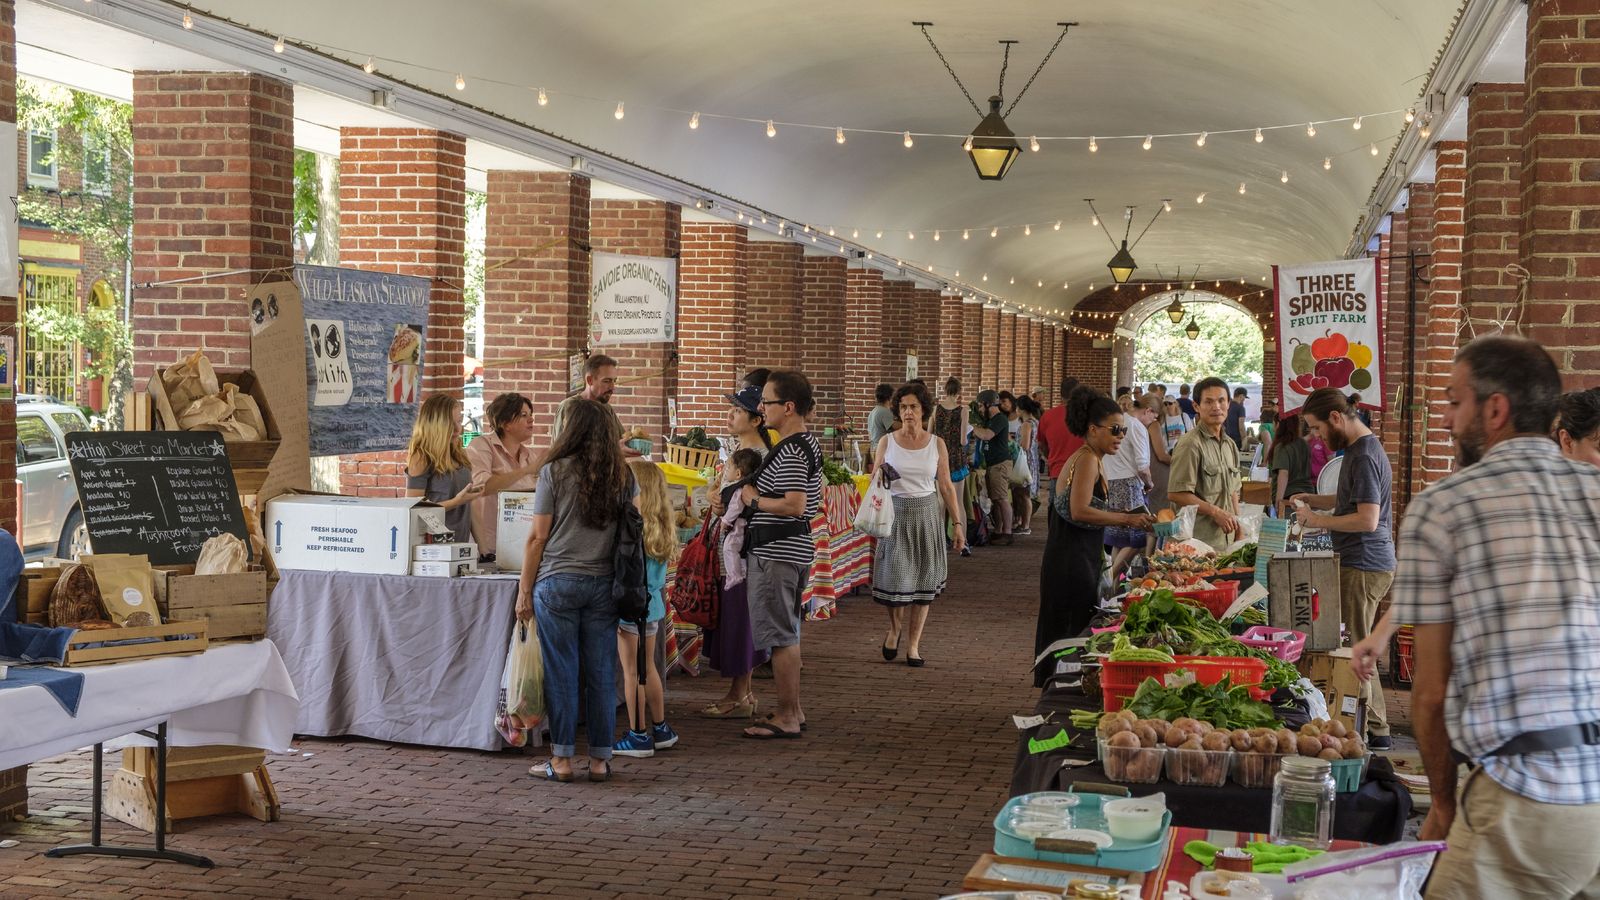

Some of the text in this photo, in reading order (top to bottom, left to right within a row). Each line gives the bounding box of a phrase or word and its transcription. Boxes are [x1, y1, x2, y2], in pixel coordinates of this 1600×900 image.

[295, 269, 425, 308] WILD ALASKAN SEAFOOD
[593, 263, 672, 305] SAVOIE ORGANIC FARM
[1295, 273, 1356, 295] THREE
[1288, 292, 1367, 317] SPRINGS
[1290, 313, 1367, 328] FRUIT FARM
[80, 438, 210, 466] High Street on Market
[80, 469, 97, 480] Apple
[330, 527, 358, 535] SEAFOOD
[322, 545, 365, 553] REFRIGERATED
[389, 552, 398, 560] UP
[1294, 582, 1310, 627] WENK
